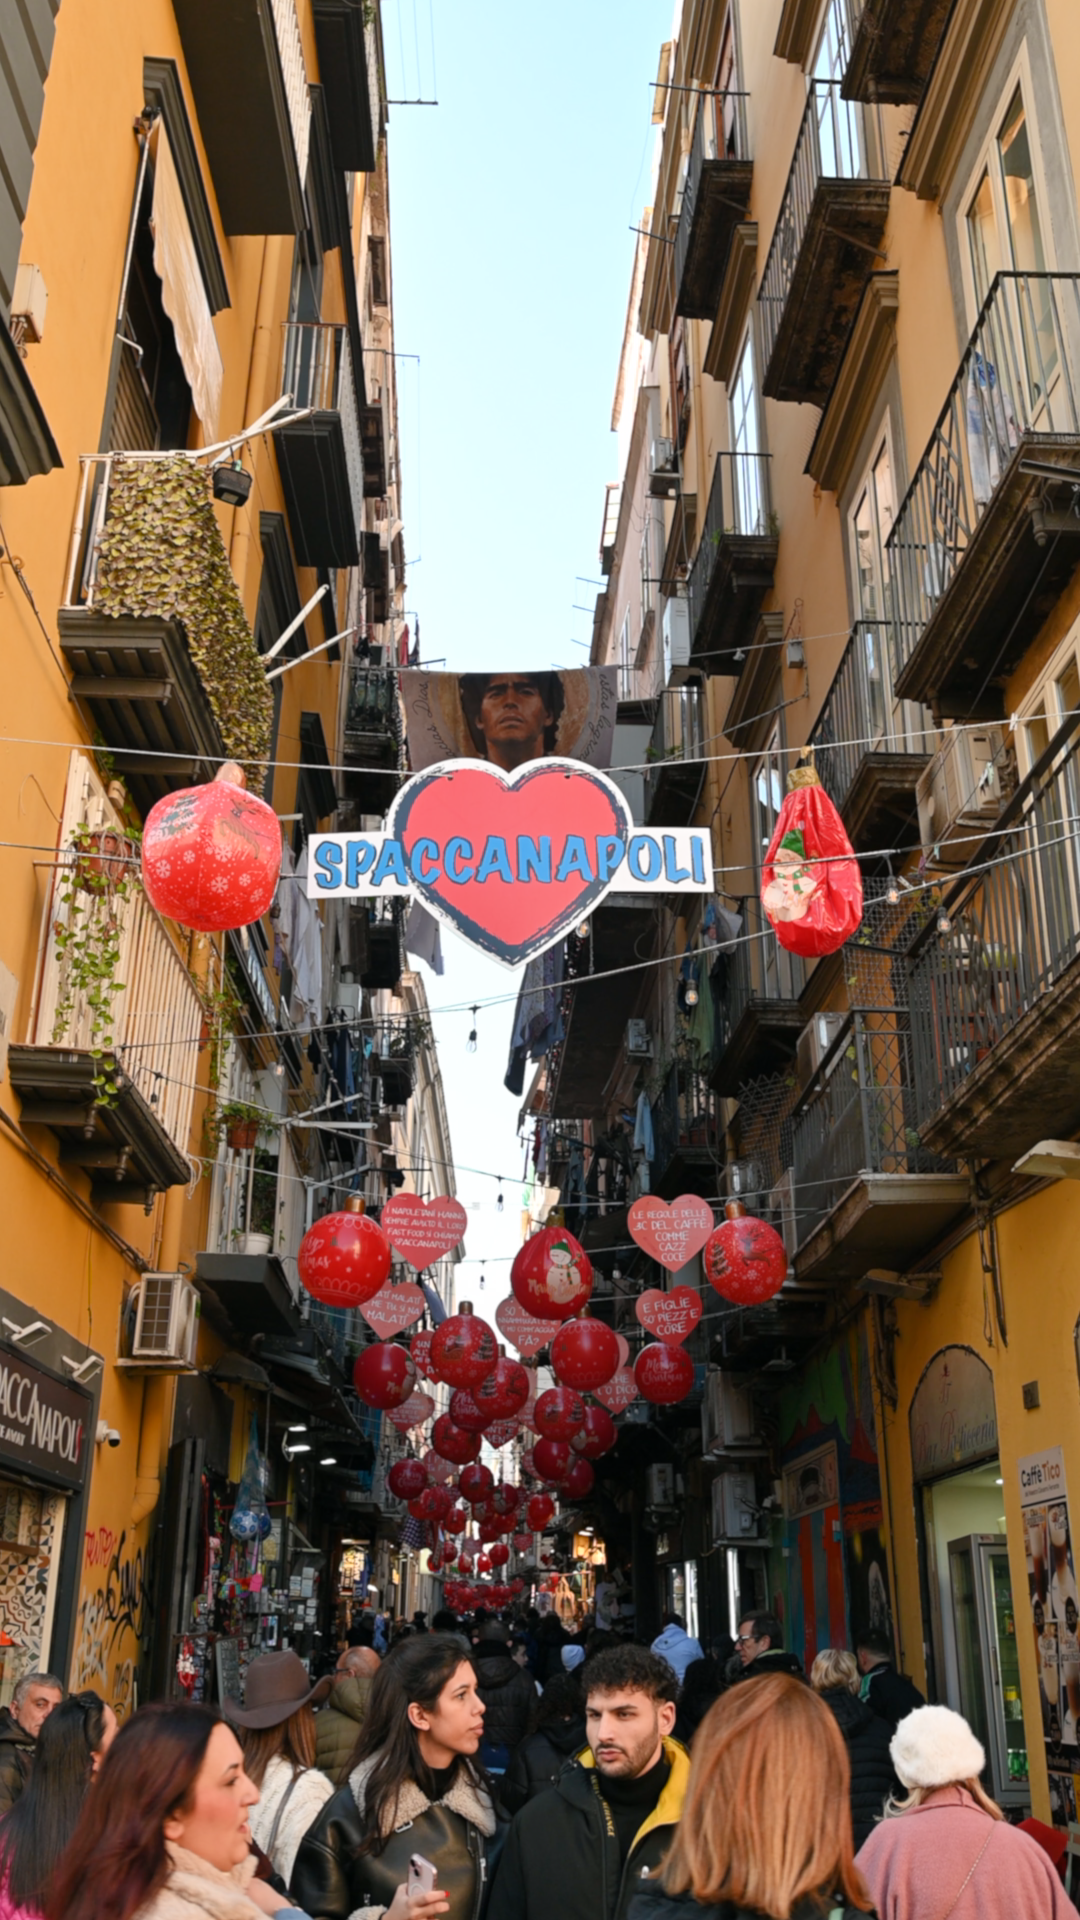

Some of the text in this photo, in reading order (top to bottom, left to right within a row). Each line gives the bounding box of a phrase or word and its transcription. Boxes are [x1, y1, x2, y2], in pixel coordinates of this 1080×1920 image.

[314, 834, 707, 889] SPACCANAPOLI
[438, 1211, 465, 1220] HANNO
[632, 1208, 707, 1219] LE REGOLE DELLE
[384, 1217, 408, 1226] SEMPRE
[447, 1222, 465, 1230] LORO
[651, 1220, 671, 1230] DEL
[387, 1228, 406, 1236] FAST
[407, 1229, 425, 1238] FOOD
[655, 1230, 689, 1241] COMME
[394, 1238, 451, 1249] SPACCANAPOLI
[659, 1242, 686, 1251] CAZZ
[661, 1252, 686, 1262] COCE
[654, 1297, 691, 1311] FIGLIE
[1021, 1460, 1061, 1488] Caffè Tico
